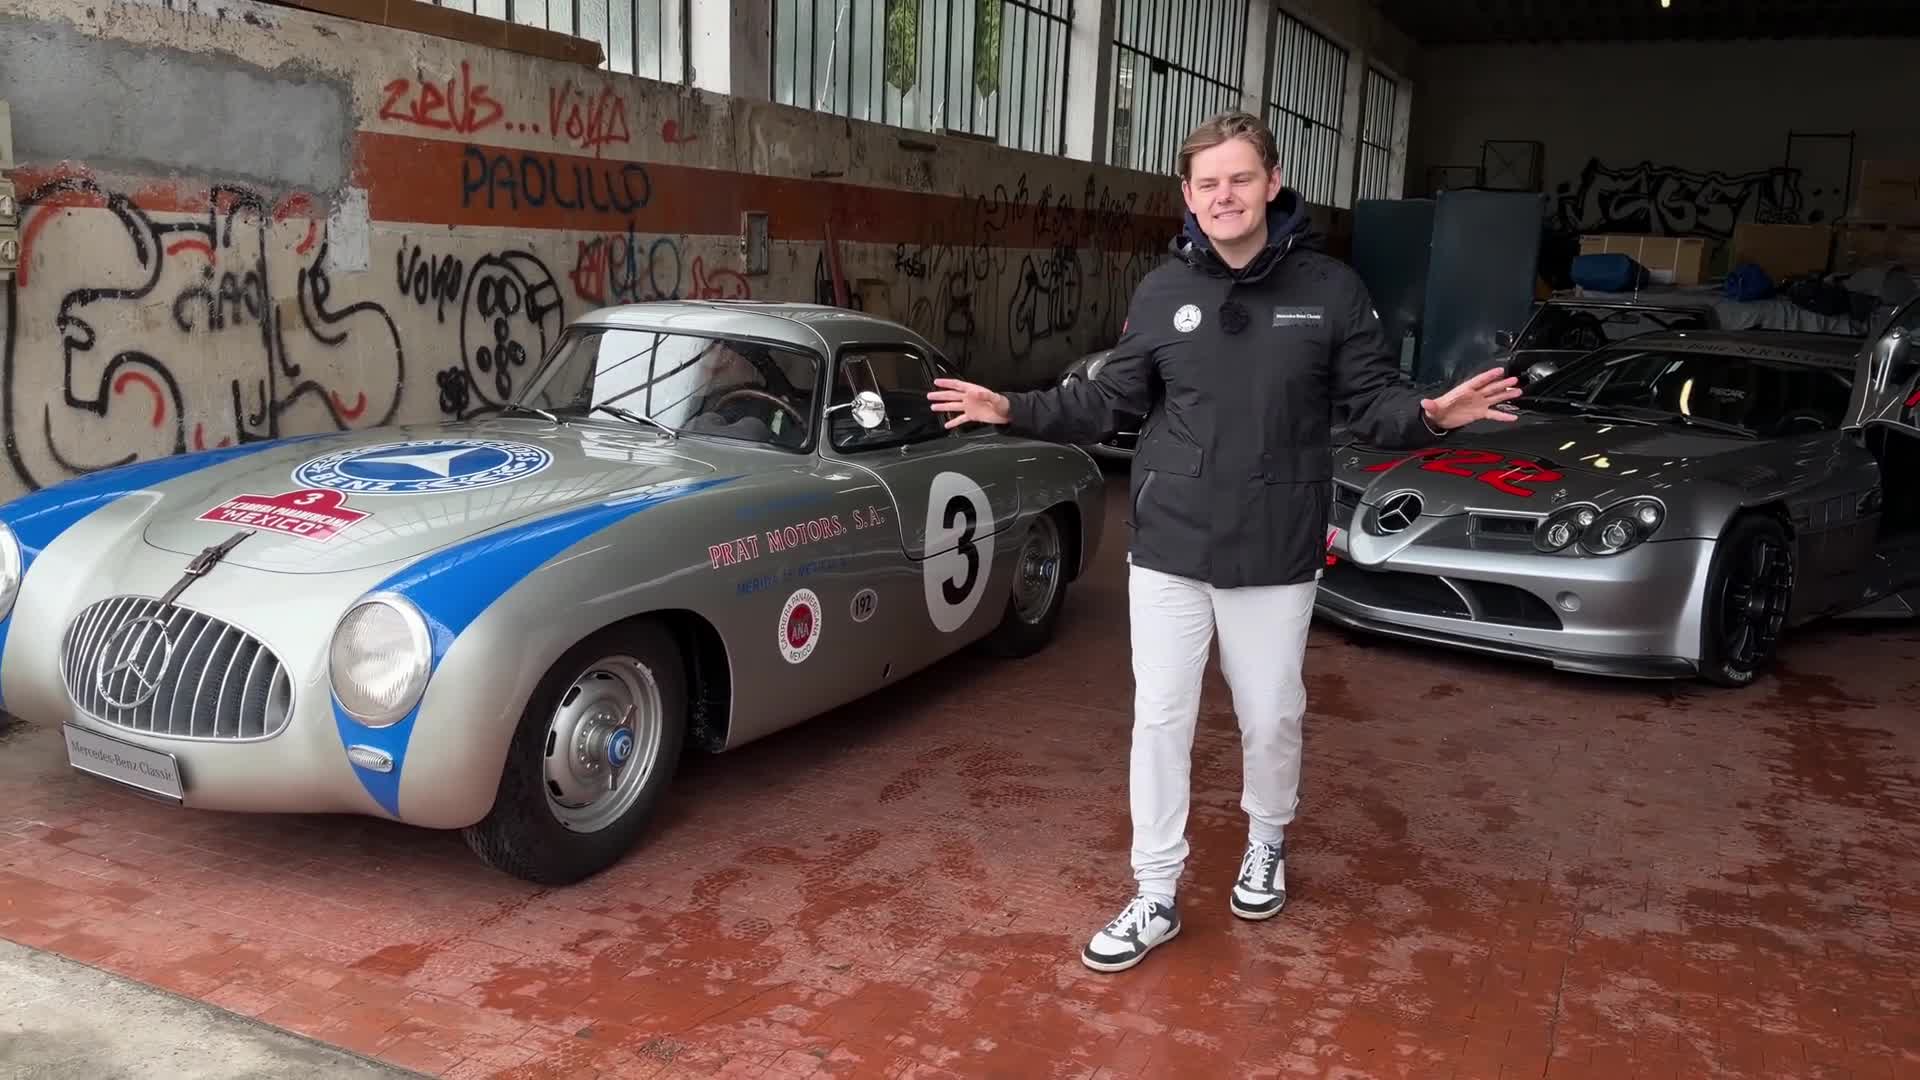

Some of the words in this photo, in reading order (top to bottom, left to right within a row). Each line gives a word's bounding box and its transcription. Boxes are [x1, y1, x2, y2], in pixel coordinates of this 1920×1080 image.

[461, 146, 652, 214] PAOLILLO
[315, 471, 397, 491] BENZ
[293, 493, 325, 505] 3
[708, 535, 760, 569] PRAT
[942, 495, 980, 606] 3
[855, 594, 872, 617] 192
[71, 740, 138, 772] Mercedes-Benz
